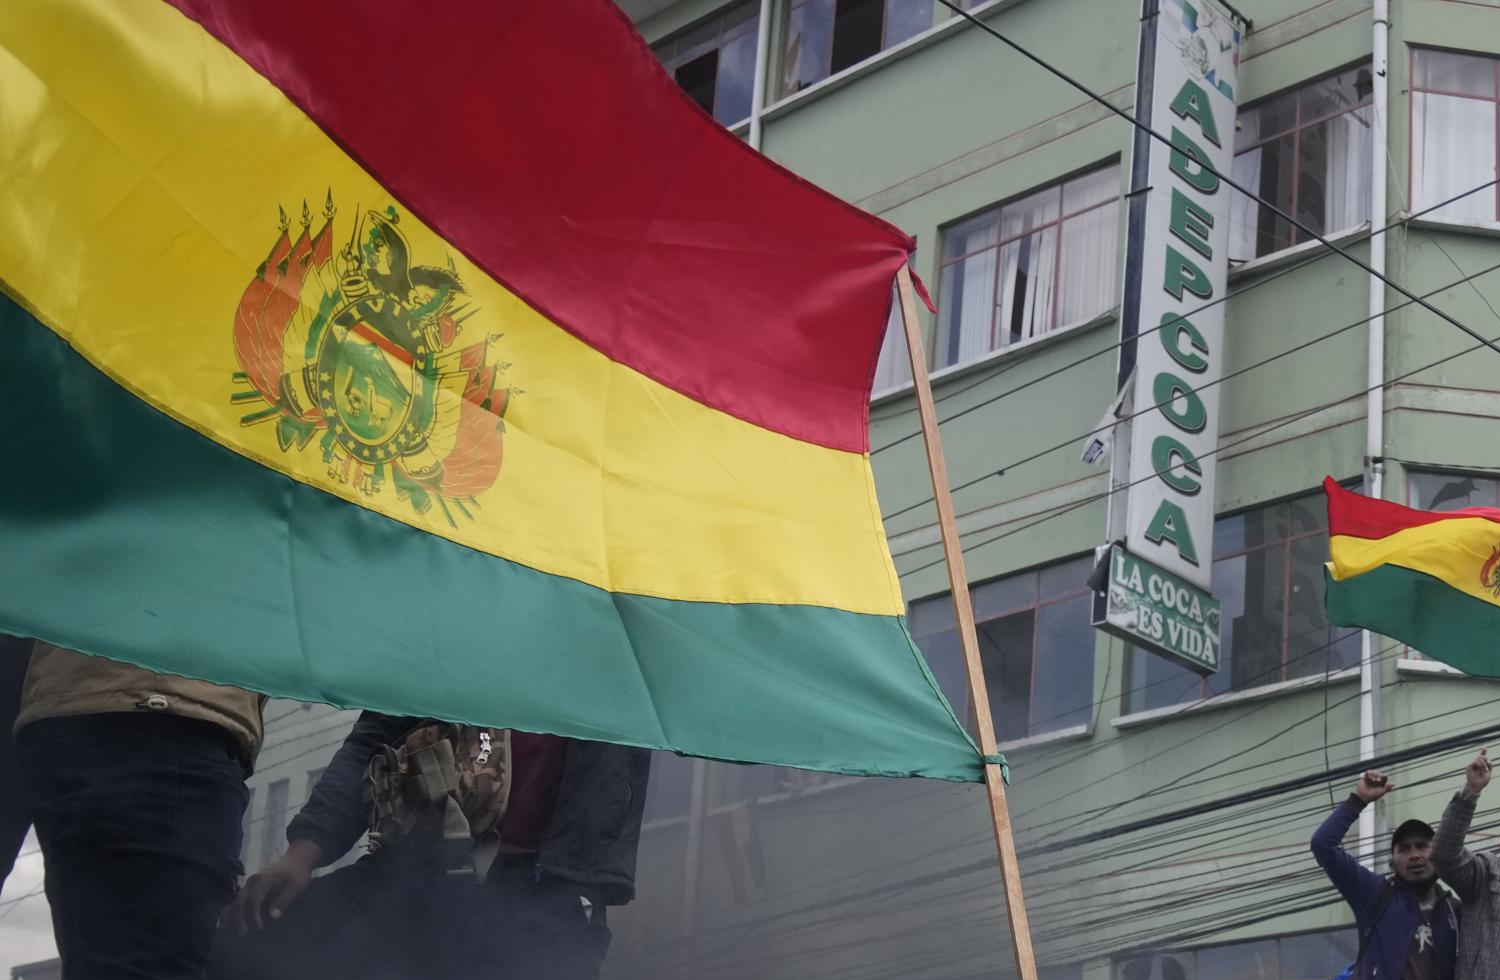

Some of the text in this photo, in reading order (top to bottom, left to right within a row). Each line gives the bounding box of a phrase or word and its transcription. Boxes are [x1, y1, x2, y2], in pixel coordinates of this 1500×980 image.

[1145, 78, 1222, 567] ADEPCOCA
[1115, 556, 1204, 622] LA COCA
[1138, 606, 1215, 664] ES VIDA
